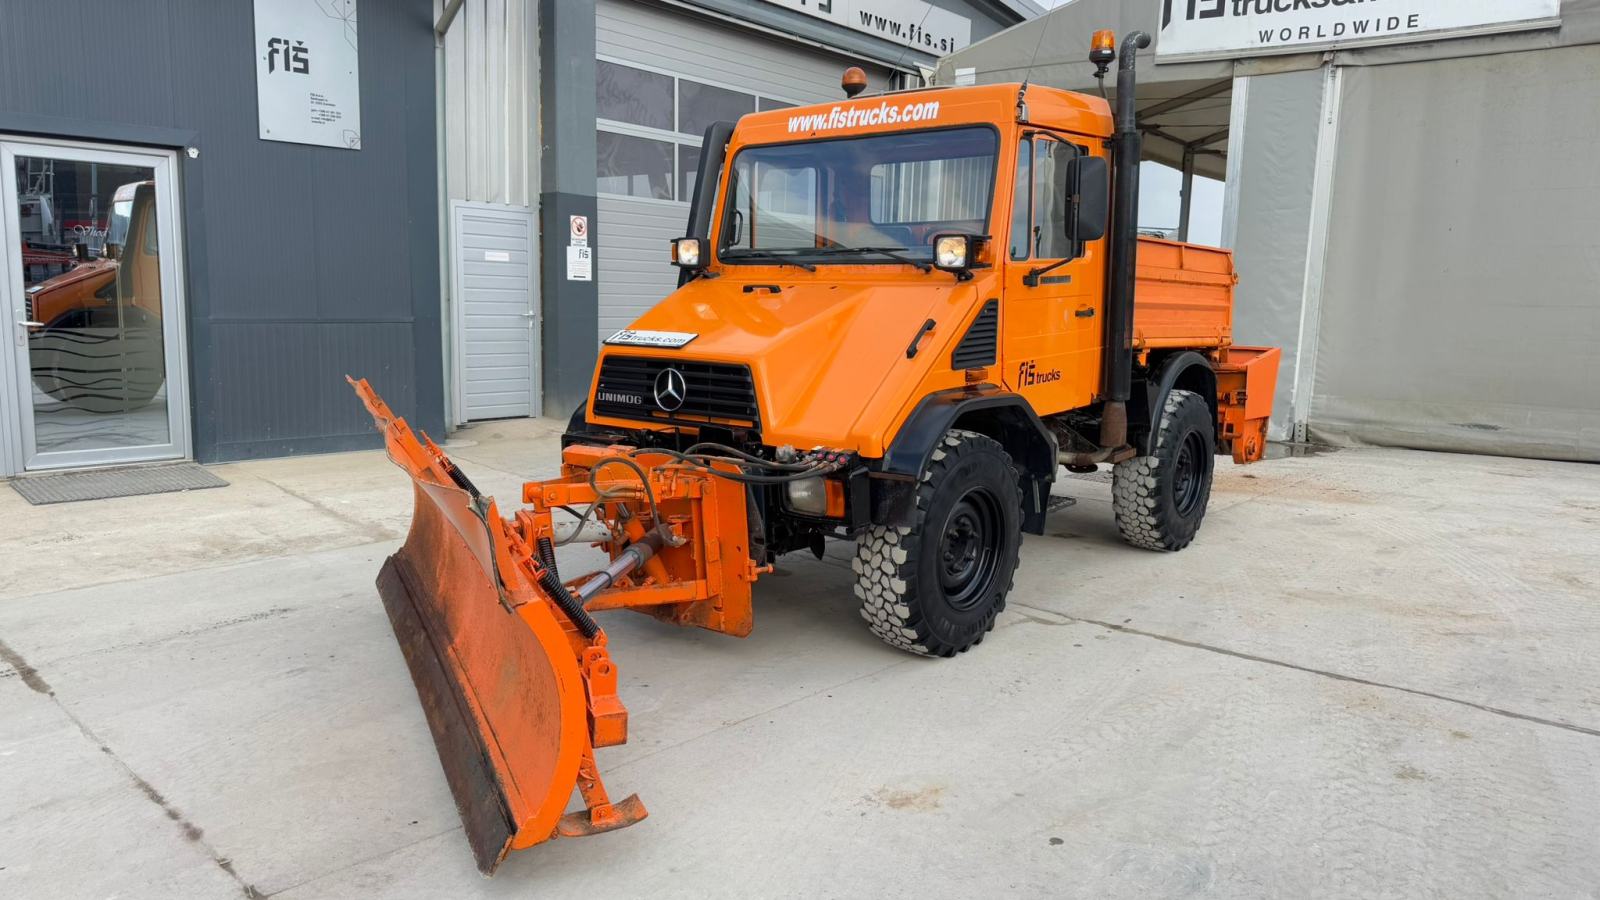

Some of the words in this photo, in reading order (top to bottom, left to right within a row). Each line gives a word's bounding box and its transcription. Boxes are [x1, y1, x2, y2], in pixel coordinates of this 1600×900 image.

[859, 10, 955, 53] www.fis.si
[1258, 14, 1420, 43] WORLDWIDE
[787, 100, 940, 133] www.fistrucks.com
[1036, 369, 1061, 384] trucks
[597, 392, 642, 405] UNIMOG
